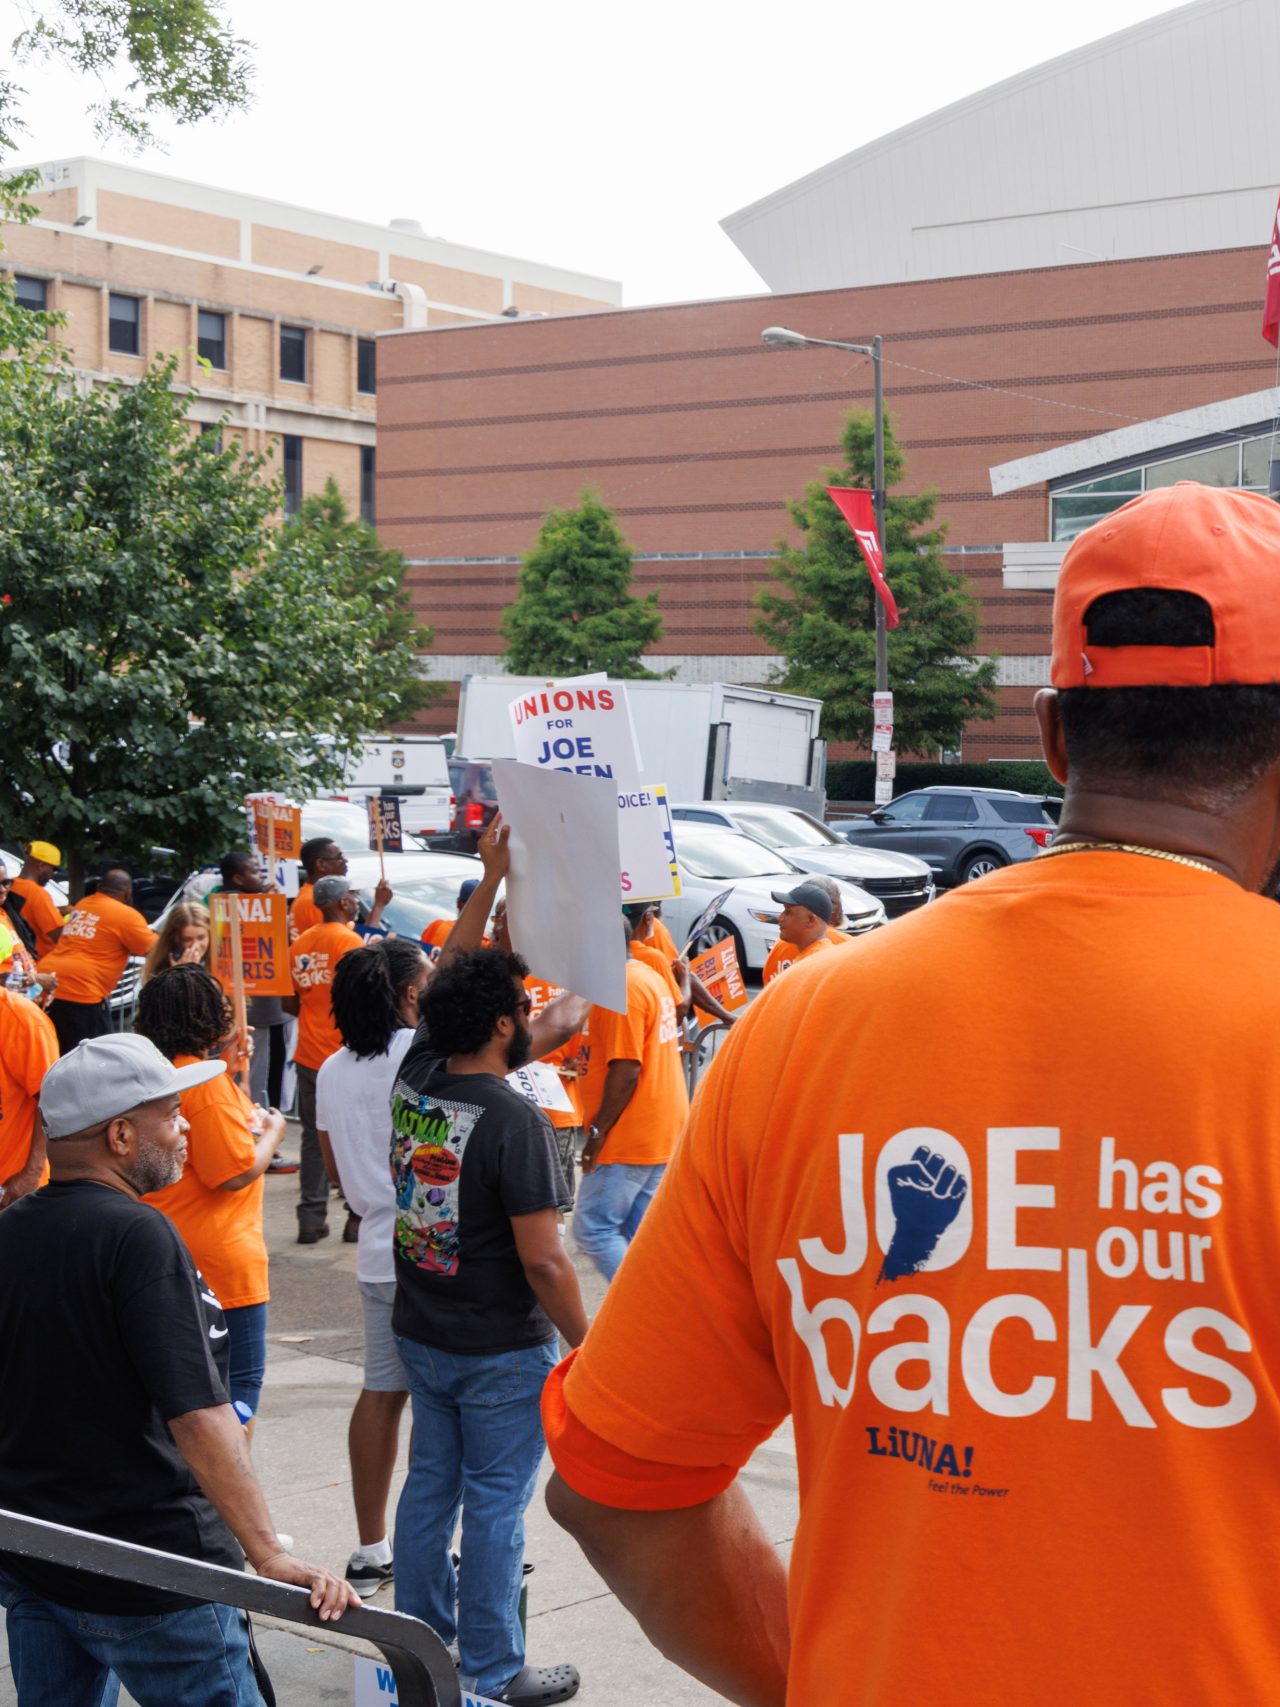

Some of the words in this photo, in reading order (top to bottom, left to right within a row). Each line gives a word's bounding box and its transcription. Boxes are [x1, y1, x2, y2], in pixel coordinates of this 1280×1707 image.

[514, 689, 615, 725] UNIONS
[546, 718, 573, 730] FOR
[537, 737, 595, 765] JOE
[798, 1126, 1062, 1277] JOE
[1097, 1137, 1224, 1218] has
[1096, 1226, 1212, 1283] our
[776, 1247, 1257, 1429] backs
[865, 1426, 974, 1478] LiUNA!
[928, 1478, 949, 1493] Feel
[950, 1483, 970, 1495] the
[972, 1484, 1010, 1497] Power
